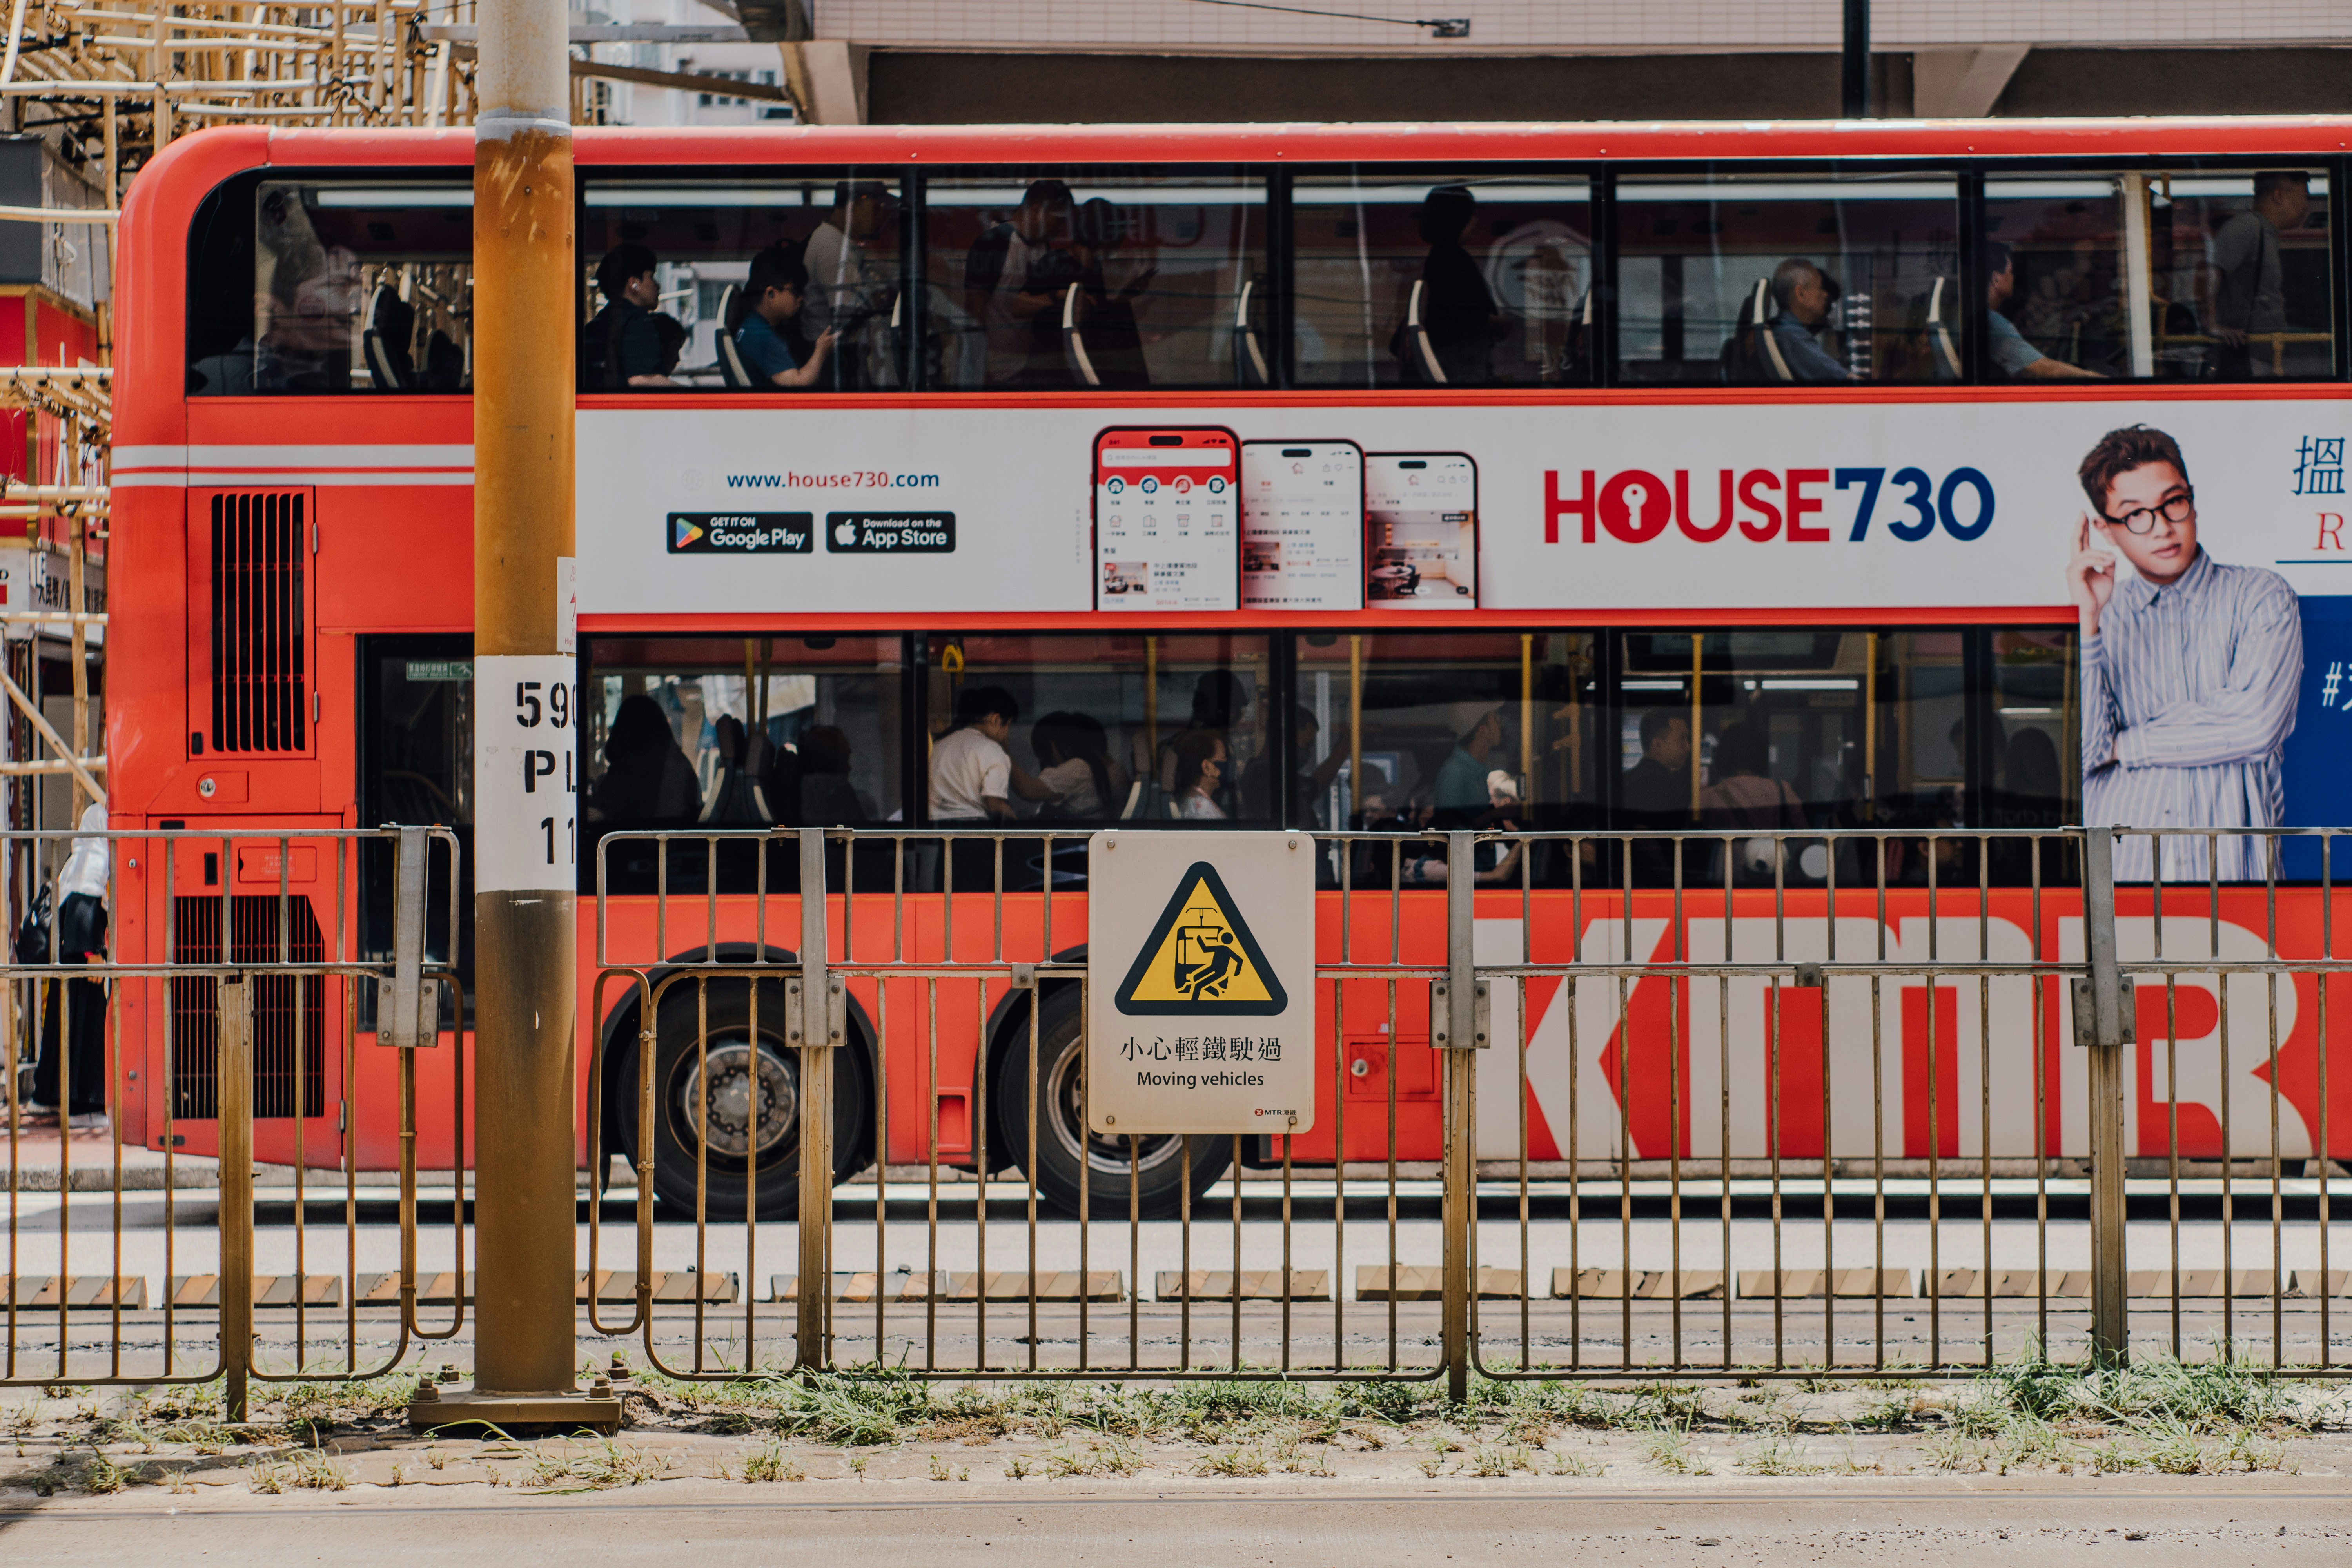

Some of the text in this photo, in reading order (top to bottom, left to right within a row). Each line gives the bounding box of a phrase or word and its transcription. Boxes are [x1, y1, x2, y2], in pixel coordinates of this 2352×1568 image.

[727, 471, 940, 488] www.house730.com
[1544, 466, 1995, 543] HOUSE730
[710, 517, 755, 526] GET IT ON
[863, 519, 908, 528] Download
[926, 518, 942, 528] the
[710, 528, 806, 549] Google Play
[862, 529, 947, 548] App Store
[2312, 513, 2345, 550] R
[1120, 1036, 1281, 1061] 小心輕鐵駛過
[1137, 1071, 1264, 1089] Moving vehicles
